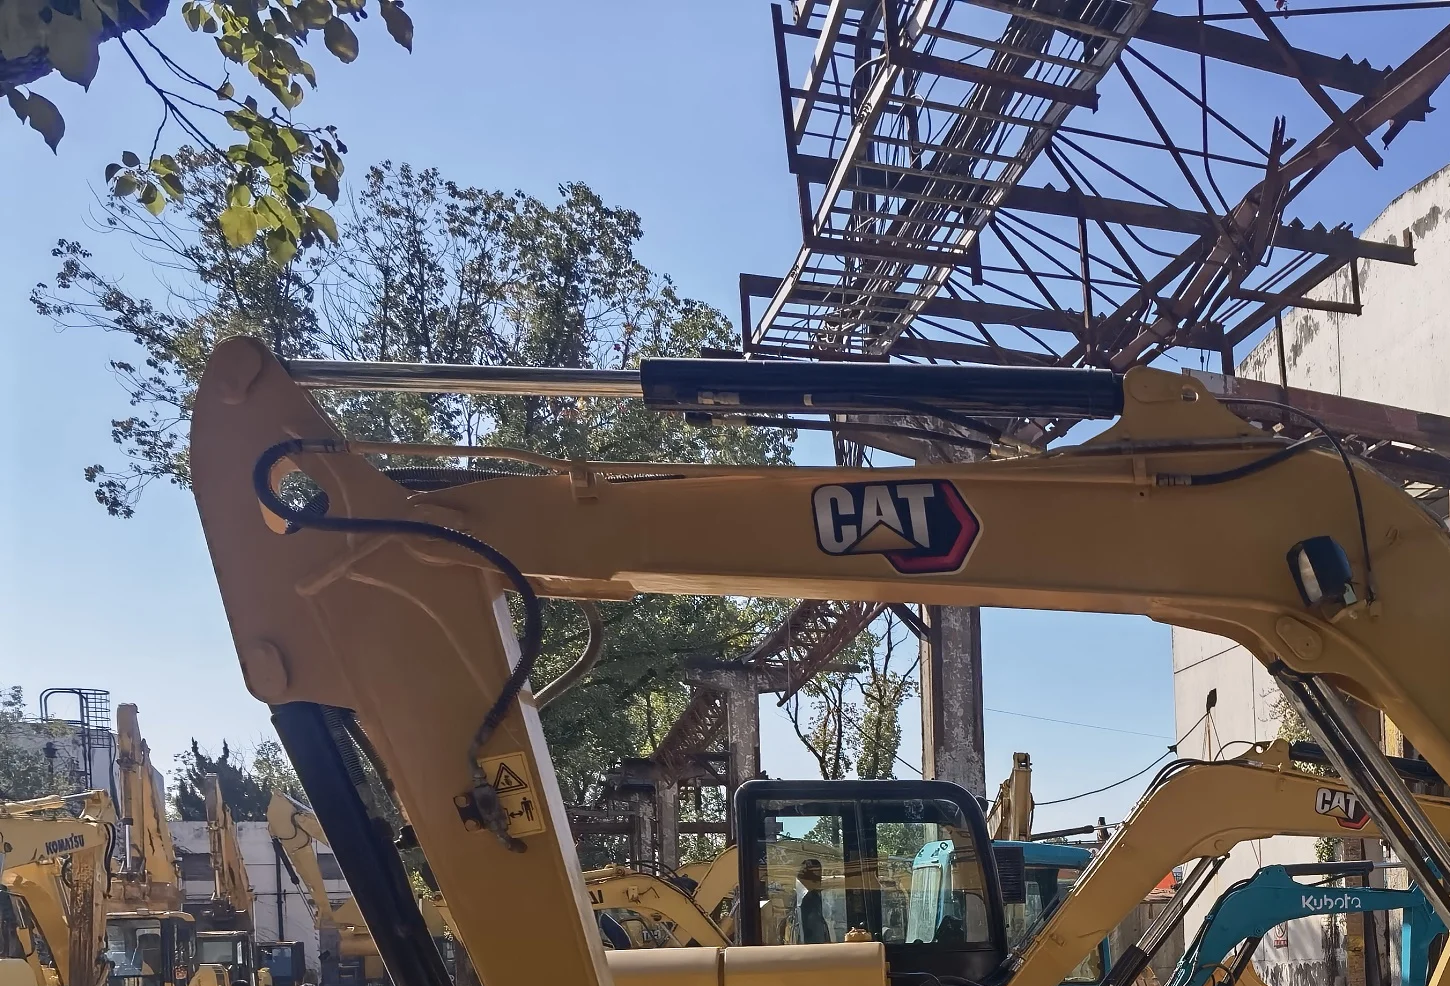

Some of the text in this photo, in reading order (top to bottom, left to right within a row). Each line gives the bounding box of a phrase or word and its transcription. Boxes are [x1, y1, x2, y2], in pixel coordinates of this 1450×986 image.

[813, 484, 935, 553] CAT
[1316, 787, 1359, 820] CAT
[45, 833, 85, 855] KOMATSU
[1302, 893, 1361, 912] Kubota
